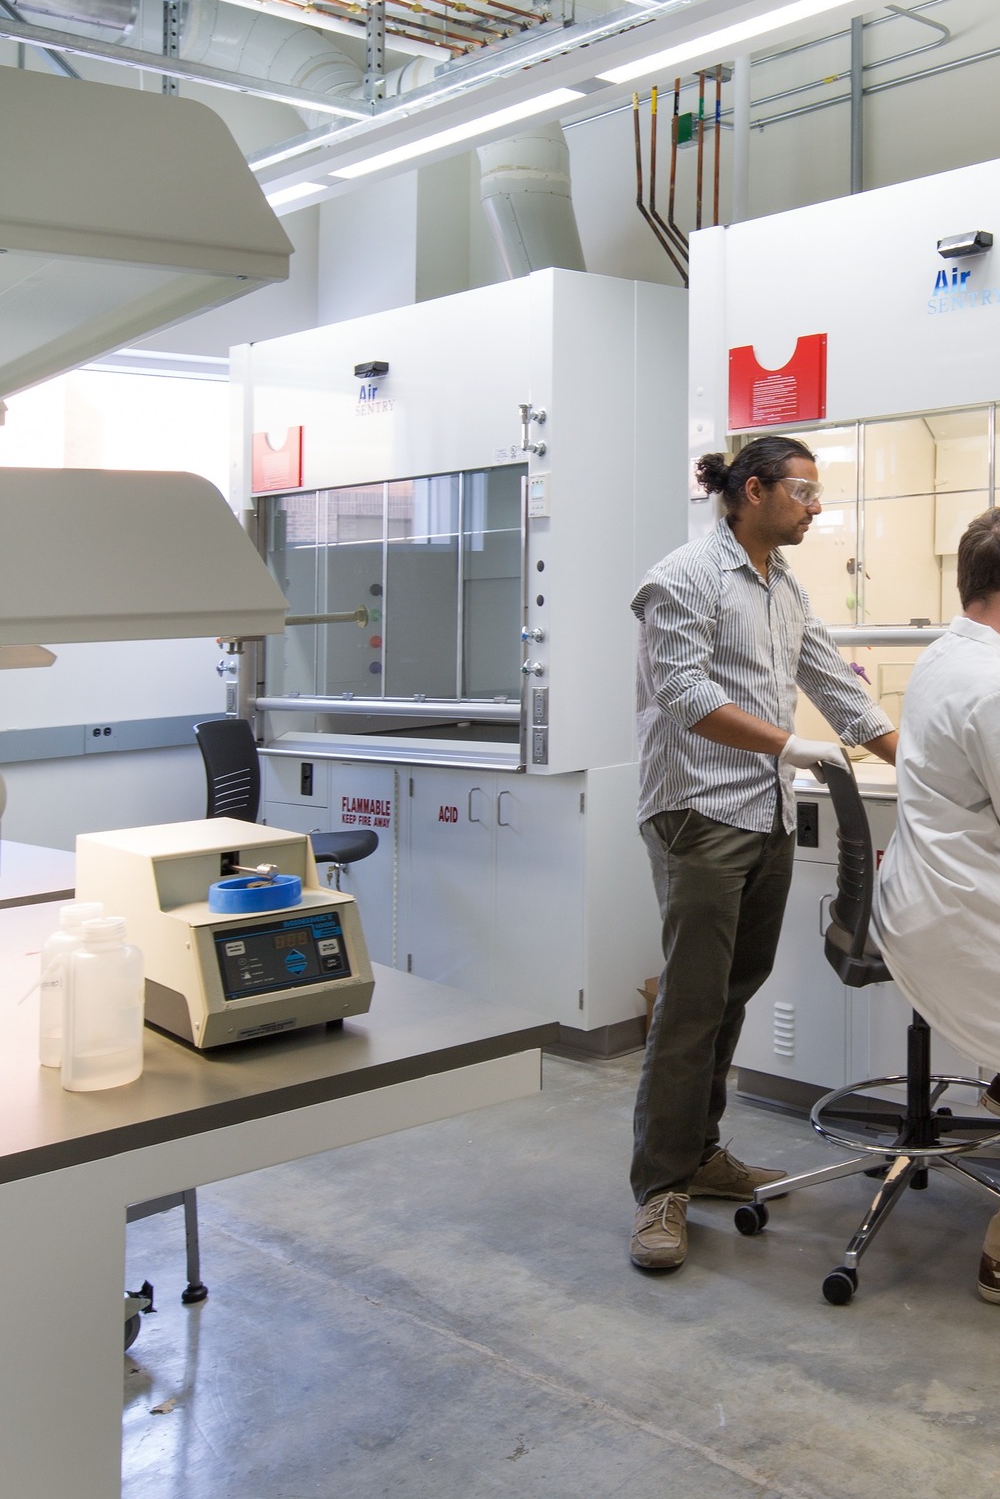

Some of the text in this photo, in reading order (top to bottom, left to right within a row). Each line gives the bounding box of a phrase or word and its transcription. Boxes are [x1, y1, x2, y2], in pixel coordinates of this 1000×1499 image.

[933, 267, 971, 297] Air
[358, 384, 378, 404] Air
[355, 399, 396, 417] SENTRY
[342, 796, 391, 816] FLAMMABLE
[438, 805, 459, 823] ACID
[342, 813, 390, 828] KEEP FIRE AWAY
